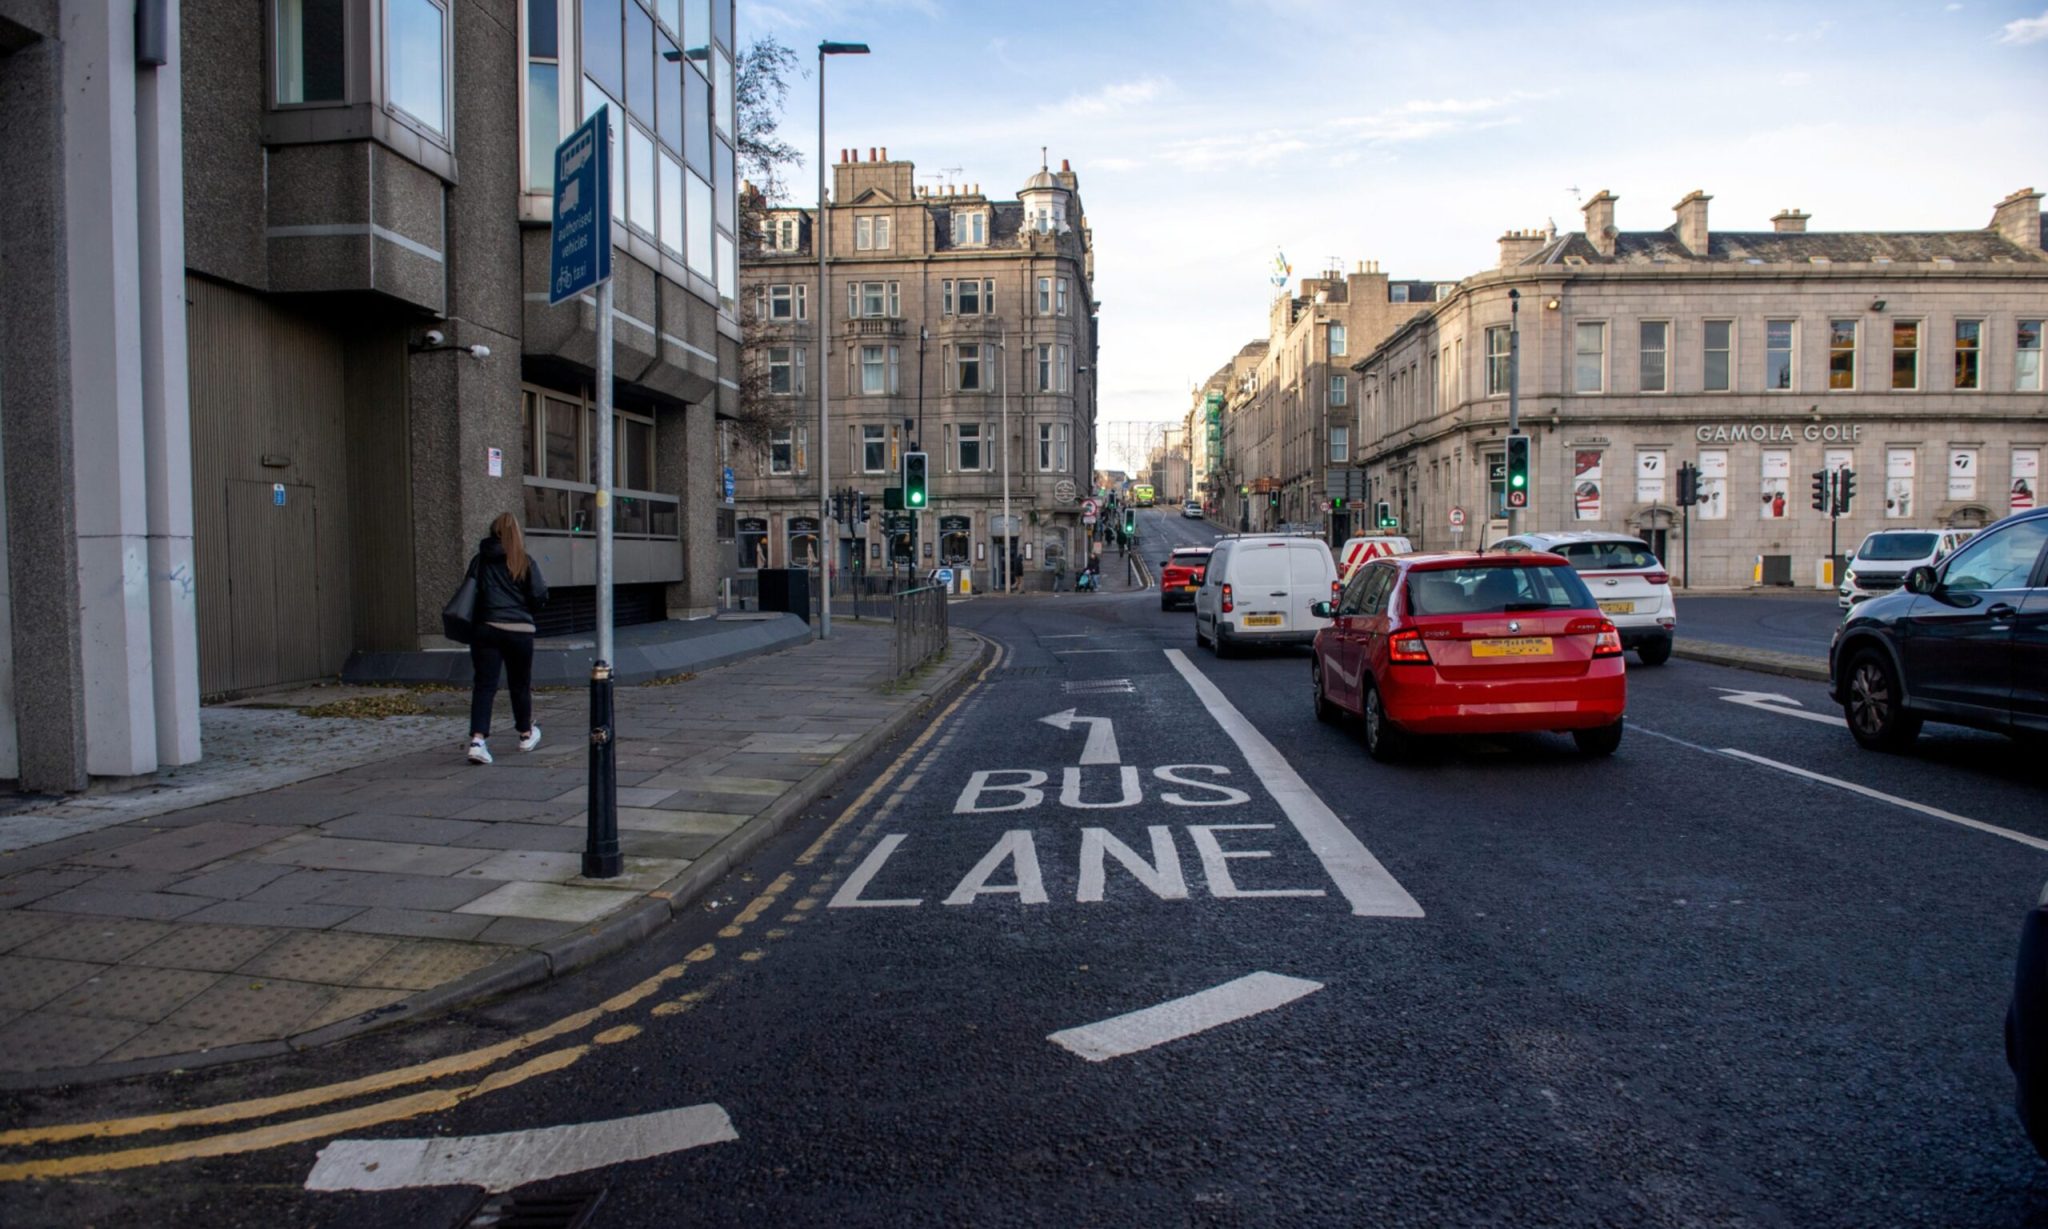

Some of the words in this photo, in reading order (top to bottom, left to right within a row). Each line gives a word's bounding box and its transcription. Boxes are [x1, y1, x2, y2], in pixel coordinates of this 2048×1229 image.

[558, 206, 592, 242] authorised
[561, 233, 588, 258] vehicles
[573, 260, 586, 280] taxi
[1696, 424, 1794, 442] GAMOLA
[1804, 424, 1861, 441] GOLF
[952, 764, 1251, 815] BUS
[826, 823, 1327, 908] LANE
